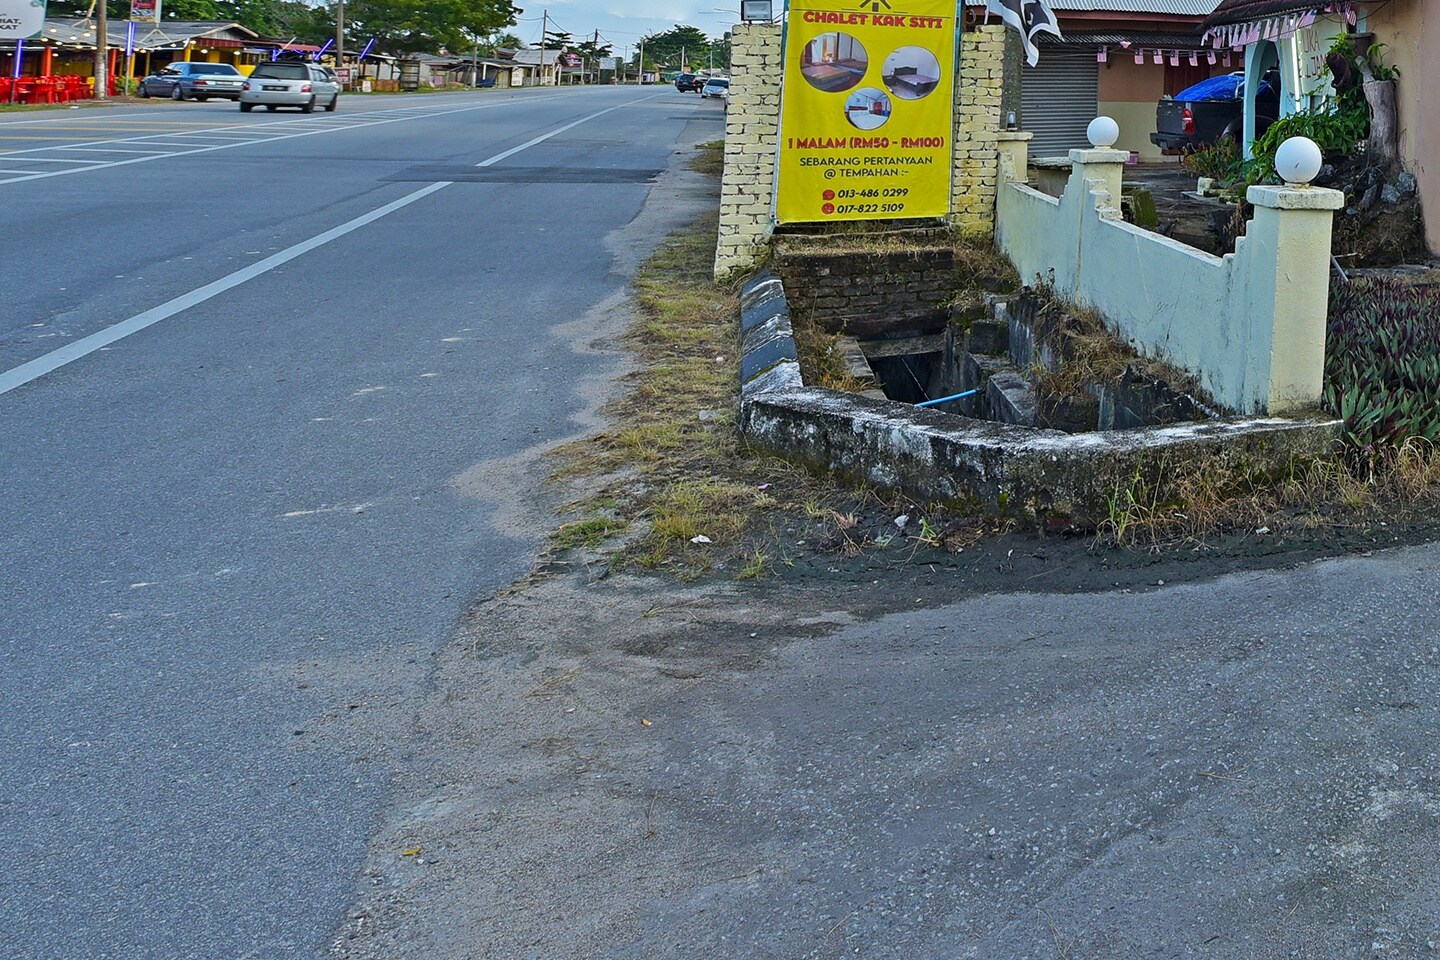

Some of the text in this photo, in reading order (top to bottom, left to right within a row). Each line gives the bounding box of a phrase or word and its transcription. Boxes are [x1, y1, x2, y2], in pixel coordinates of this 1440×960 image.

[803, 11, 943, 29] CHALET KAK SITI
[788, 137, 794, 149] 1
[796, 137, 846, 149] MALAM
[850, 137, 889, 149] (RM50
[901, 136, 944, 148] RM100)
[800, 156, 933, 167] SEBARANG PERTANYAAN
[824, 168, 837, 179] @
[840, 168, 898, 177] TEMPAHAN
[838, 188, 909, 199] 013-486 0299
[837, 203, 904, 214] 017-822 5109
